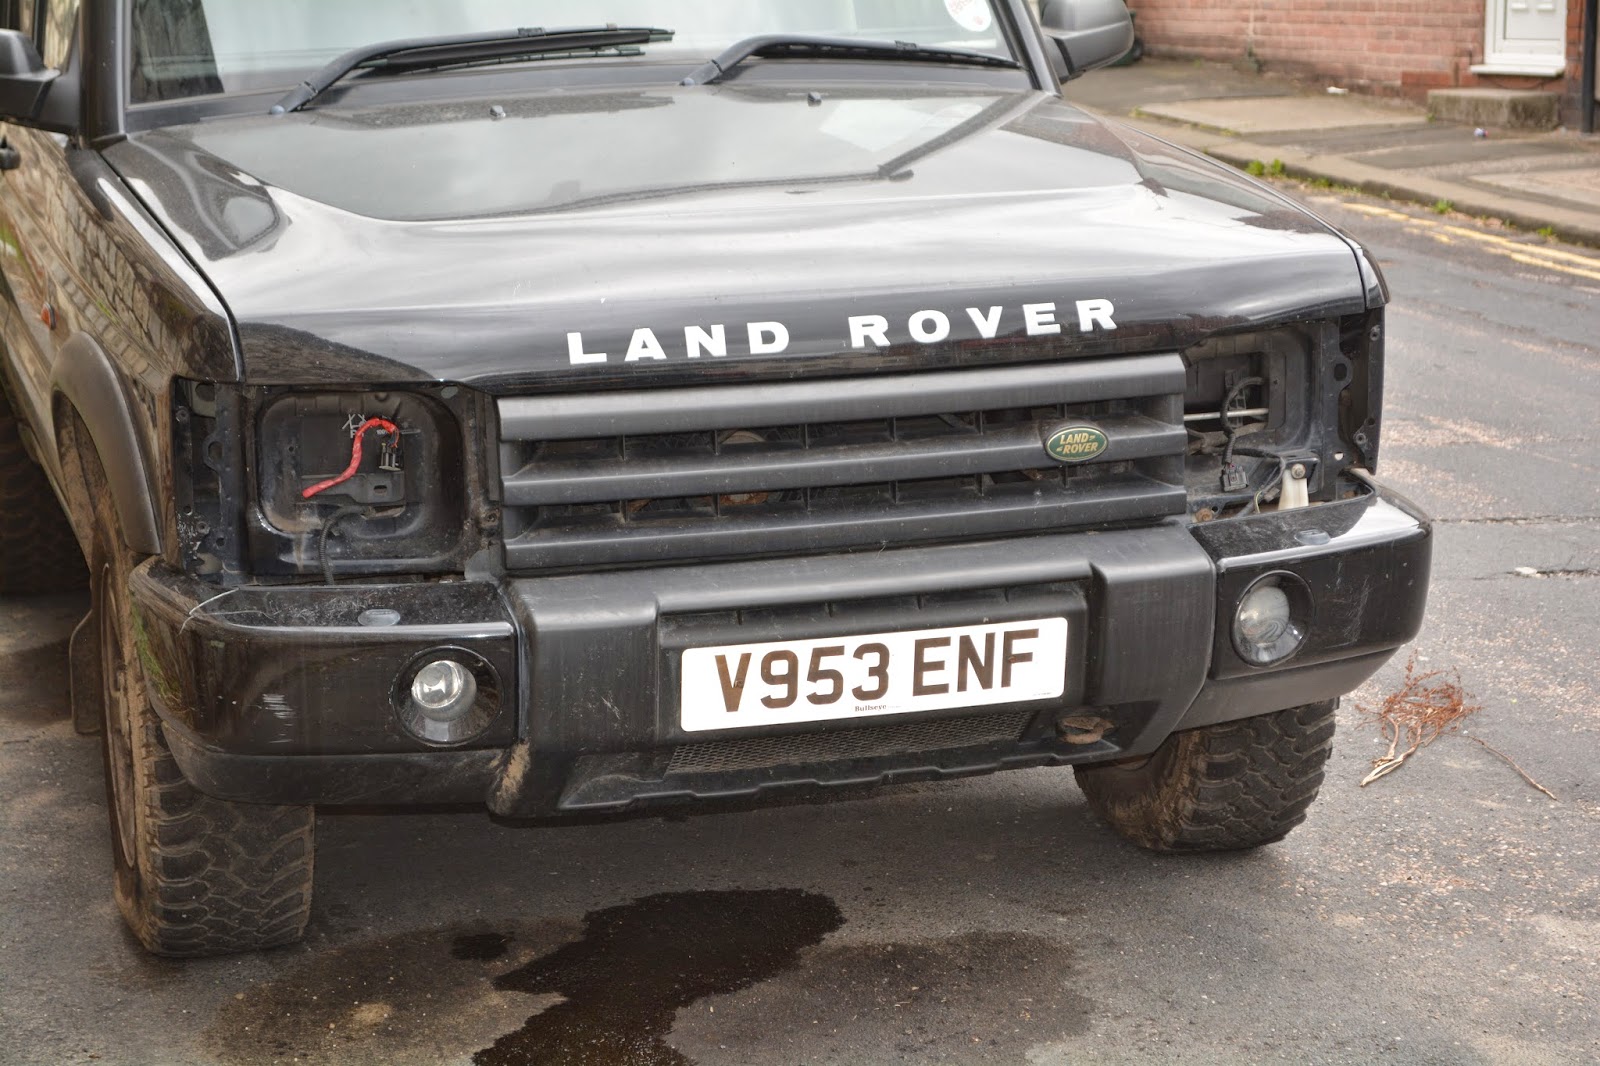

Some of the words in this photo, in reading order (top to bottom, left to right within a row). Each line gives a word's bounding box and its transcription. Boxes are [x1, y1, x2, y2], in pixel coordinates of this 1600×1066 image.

[567, 320, 790, 365] LAND
[848, 298, 1117, 348] ROVER
[1060, 433, 1089, 444] LAND
[1062, 442, 1099, 454] ROVER
[714, 642, 890, 713] V953
[912, 628, 1040, 697] ENF
[854, 704, 887, 712] Bullseye
